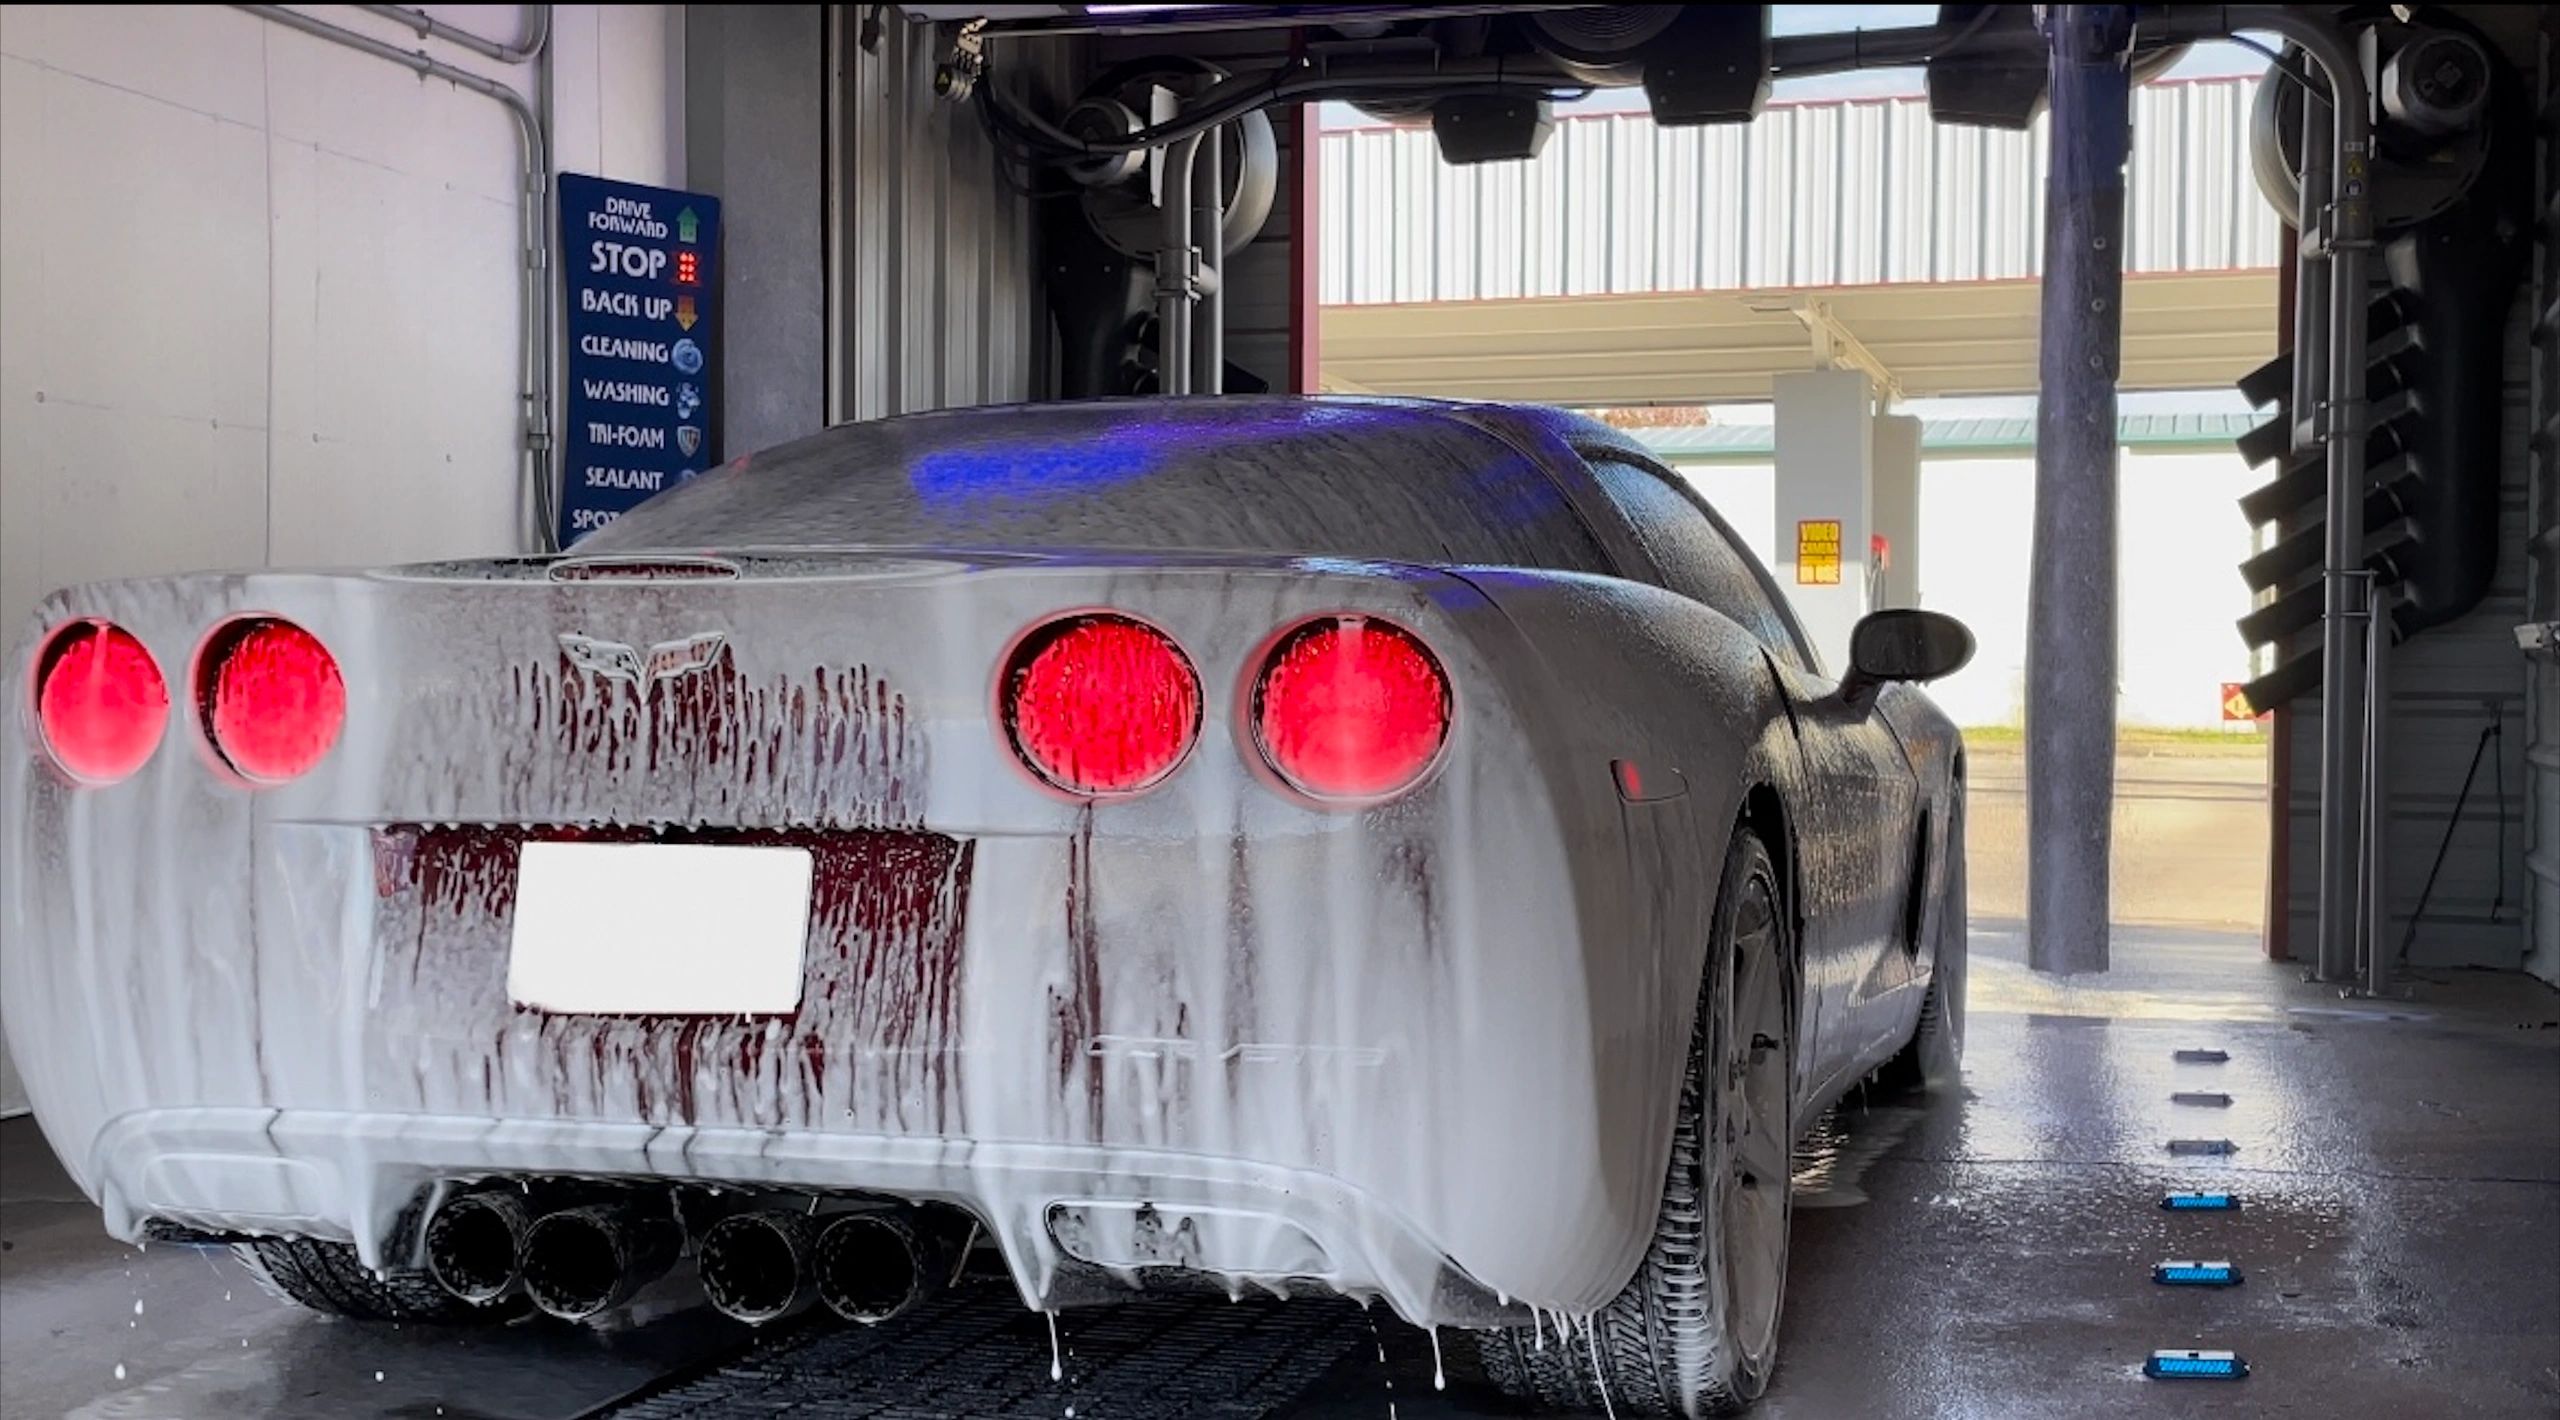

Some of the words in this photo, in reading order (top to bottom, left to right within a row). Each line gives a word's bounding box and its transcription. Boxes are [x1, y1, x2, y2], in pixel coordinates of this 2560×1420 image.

[605, 196, 652, 219] DRIVE
[588, 211, 669, 239] FORWARD
[590, 240, 667, 280] STOP
[581, 288, 639, 317] BACK
[644, 297, 673, 321] UP
[581, 335, 669, 363] CLEANING
[583, 378, 670, 406] WASHING
[588, 422, 664, 449] TRI-FOAM
[585, 466, 664, 491] SEALANT
